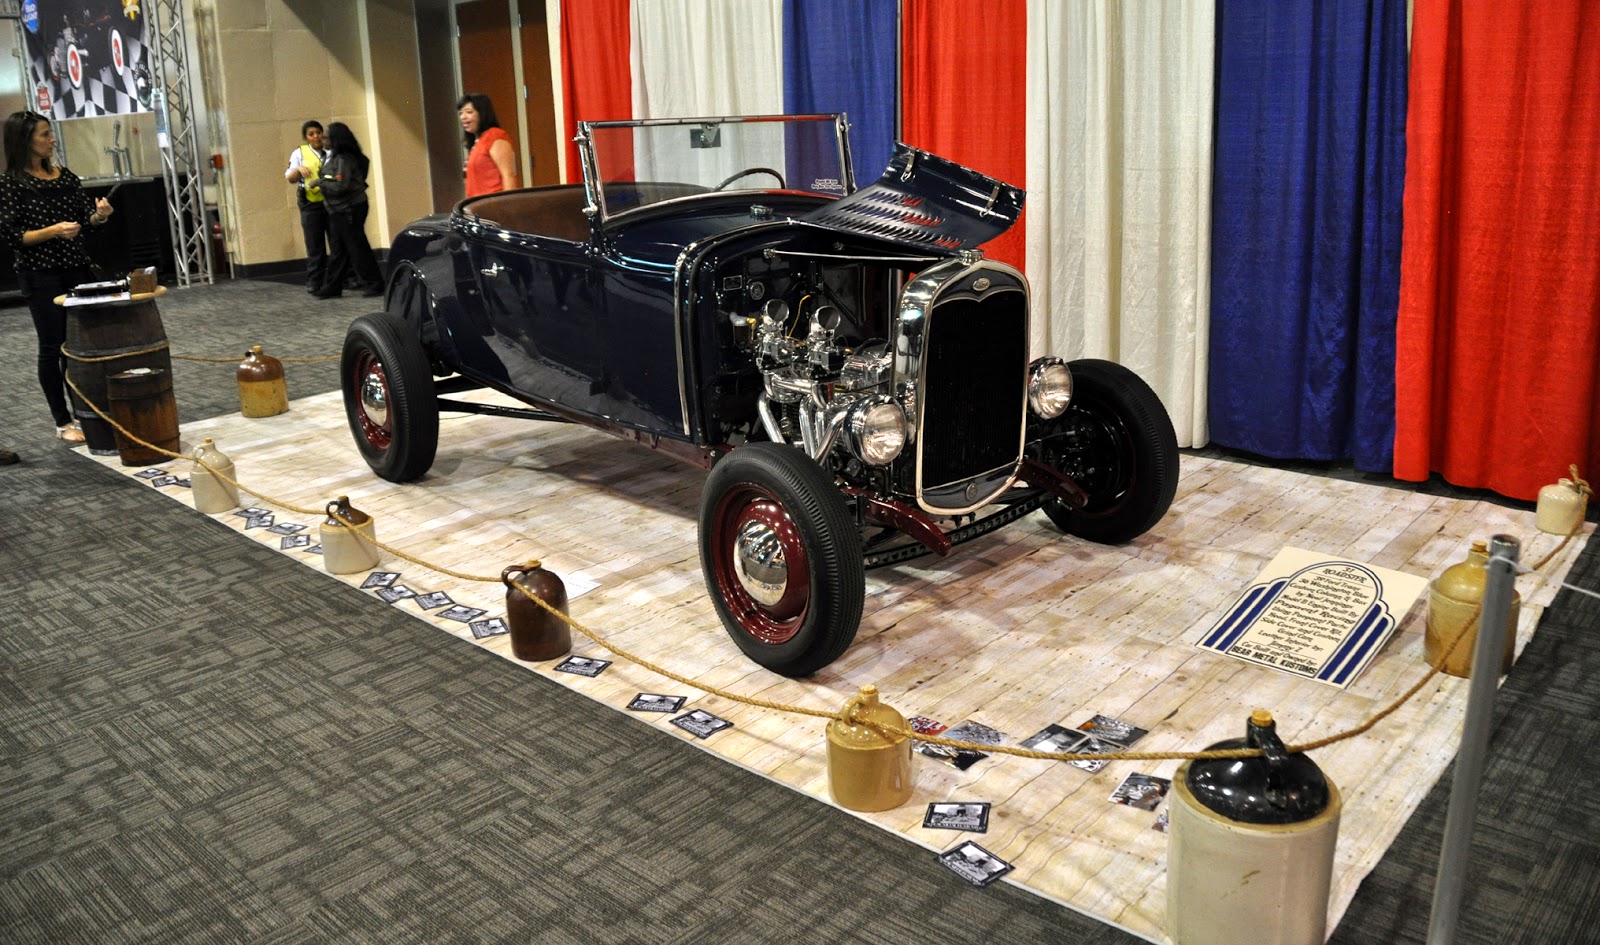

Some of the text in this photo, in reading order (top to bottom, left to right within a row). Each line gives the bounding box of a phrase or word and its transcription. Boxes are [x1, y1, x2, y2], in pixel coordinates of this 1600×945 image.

[1323, 568, 1367, 583] ROADSTER
[1289, 583, 1315, 593] Custom
[1316, 589, 1342, 600] Column
[1310, 580, 1351, 595] Washington
[1352, 591, 1369, 599] Blue
[1281, 594, 1301, 602] Model
[1307, 601, 1329, 610] Engine
[1289, 617, 1309, 626] Front
[1308, 623, 1328, 631] Cover
[1319, 611, 1356, 624] Racing
[1258, 630, 1284, 640] Leather
[1285, 637, 1310, 647] Interior
[1313, 631, 1340, 643] Custom
[1231, 645, 1318, 674] BEAR METAL KUSTOMS
[1283, 653, 1308, 663] Owned
